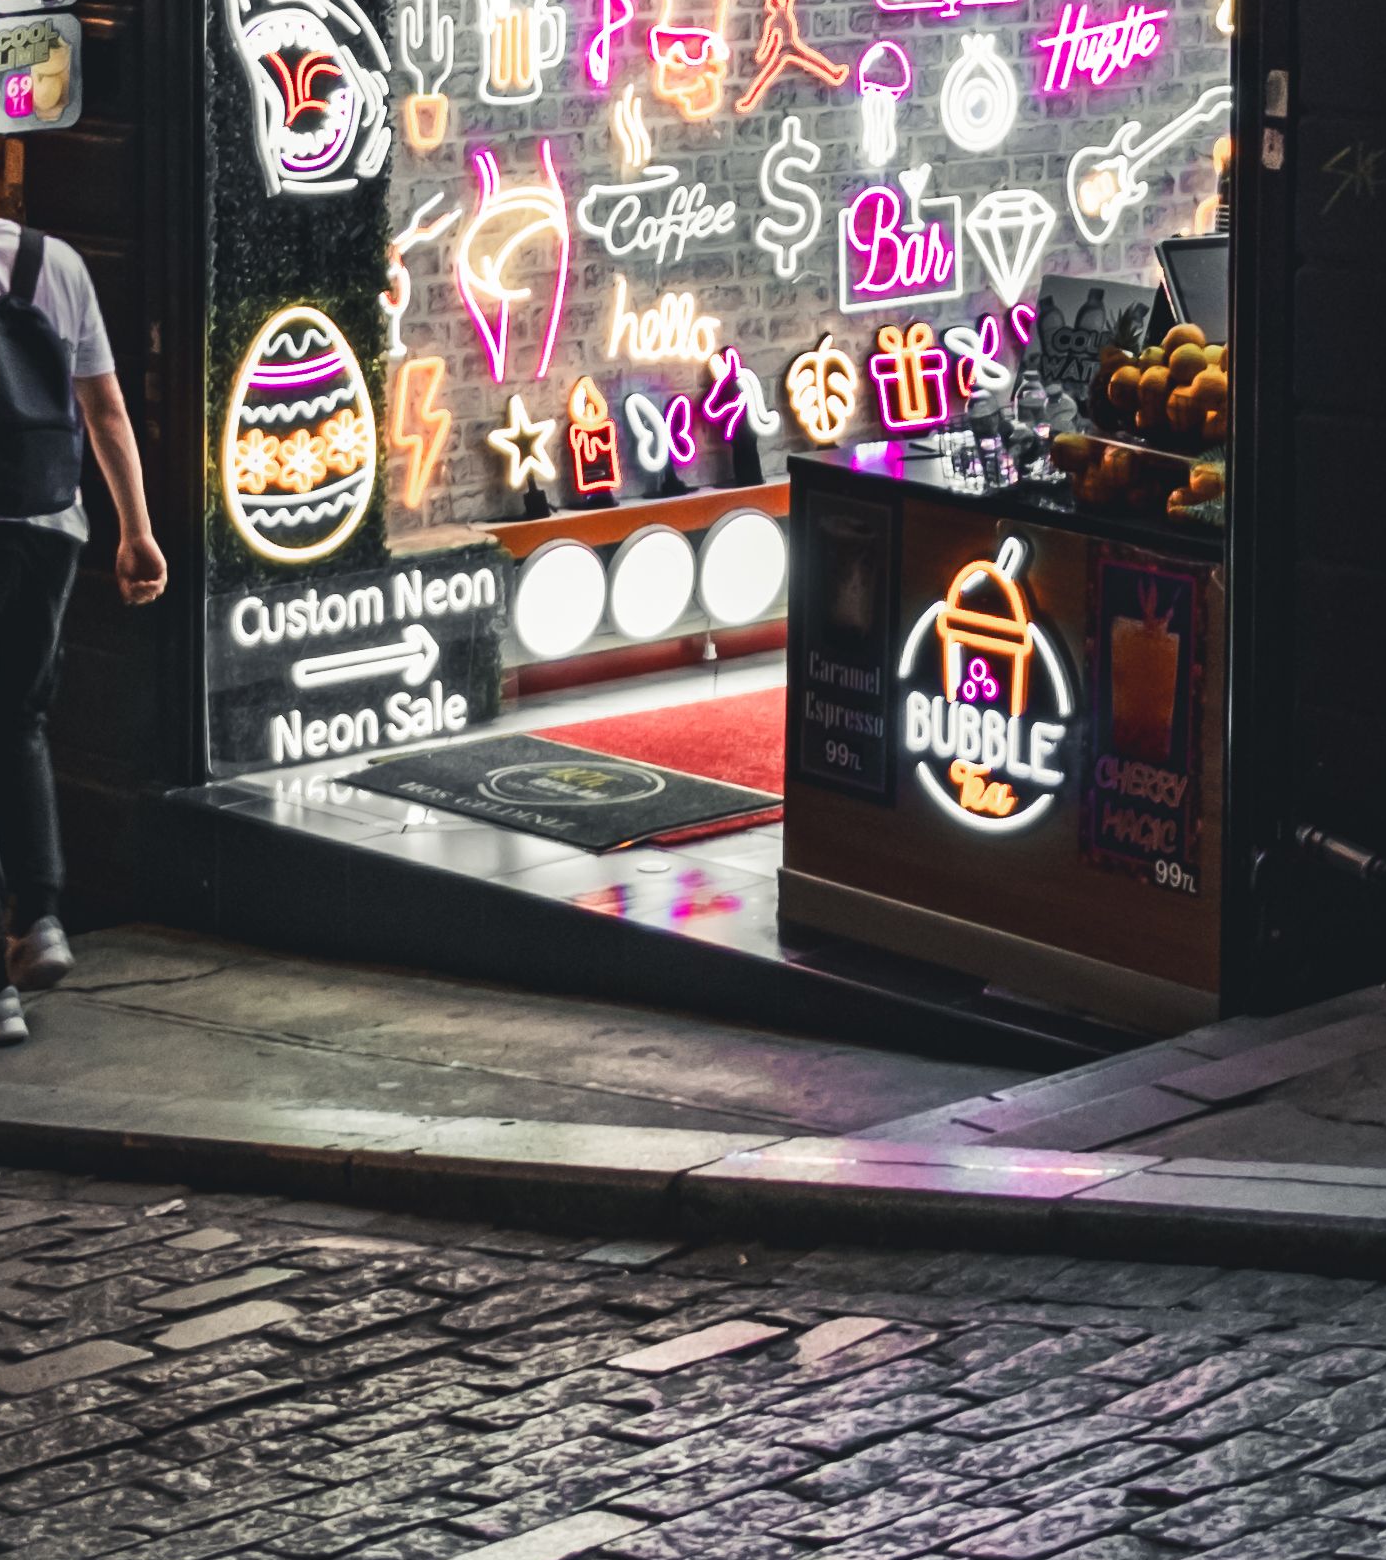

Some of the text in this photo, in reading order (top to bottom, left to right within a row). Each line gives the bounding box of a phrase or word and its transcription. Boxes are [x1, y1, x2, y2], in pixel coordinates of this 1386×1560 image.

[6, 75, 33, 98] 69
[603, 181, 738, 266] Coffee
[846, 185, 956, 293] Bar
[607, 279, 722, 361] hello
[1040, 355, 1101, 382] WAT
[232, 566, 498, 648] Custom Neon
[808, 649, 881, 696] Caramel
[269, 678, 469, 764] Neon Sale
[805, 690, 884, 739] Espresso
[904, 690, 1066, 786] BUBBLE
[949, 759, 1018, 817] Tea
[1094, 753, 1189, 809] CHERRY
[1100, 801, 1178, 855] MAGIC
